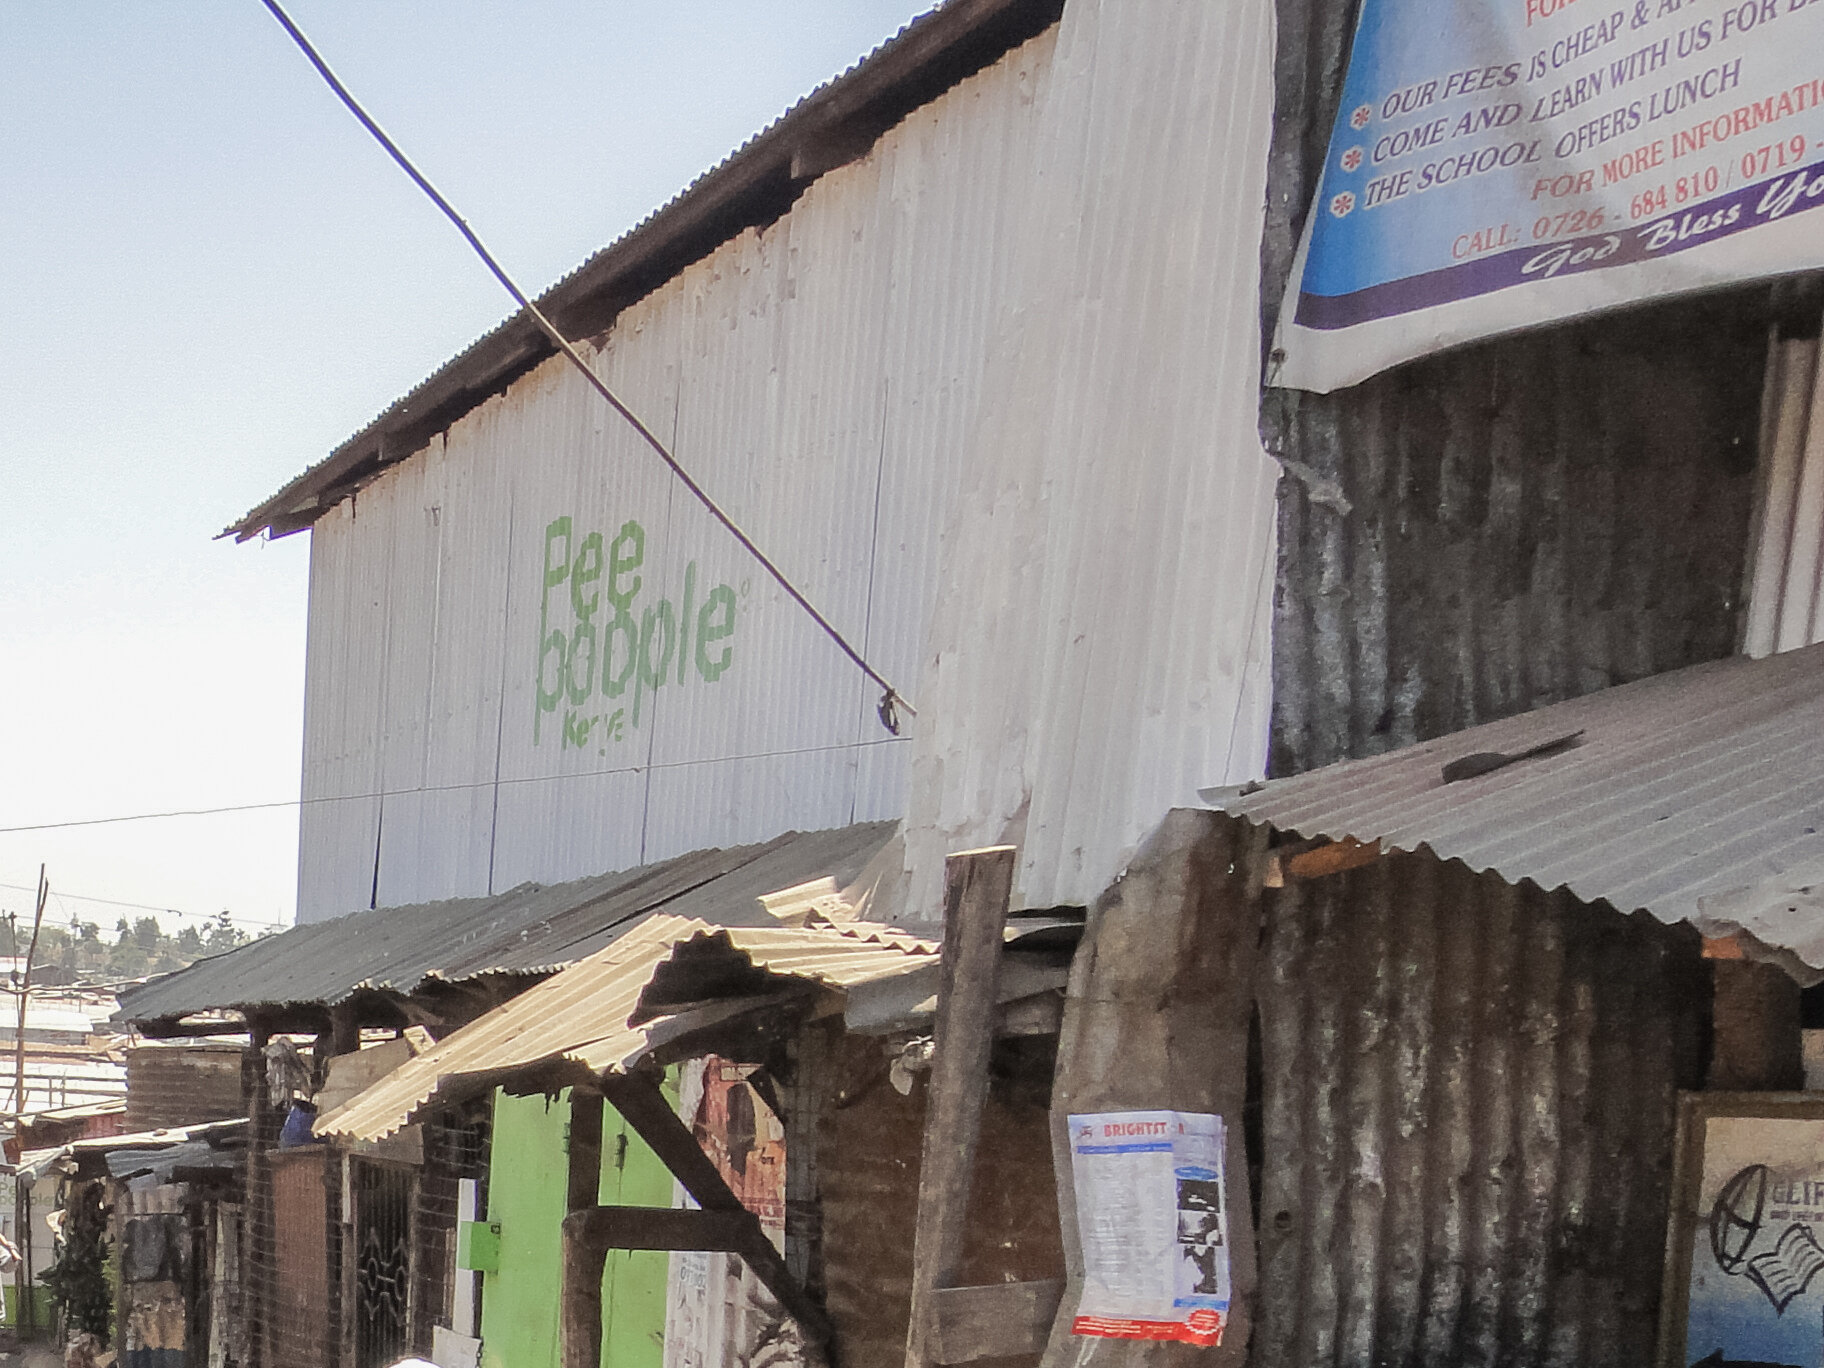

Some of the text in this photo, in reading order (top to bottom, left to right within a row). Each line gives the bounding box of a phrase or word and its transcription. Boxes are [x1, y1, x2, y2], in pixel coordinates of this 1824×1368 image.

[1374, 117, 1450, 163] COME
[1451, 102, 1524, 139] AND
[1528, 68, 1606, 123] LEARN
[1609, 37, 1670, 90] WITH
[1677, 19, 1713, 59] US
[1719, 0, 1777, 41] FOR
[1382, 80, 1439, 120] OUR
[1442, 62, 1522, 100] FEES
[1526, 50, 1547, 83] IS
[1551, 11, 1625, 69] CHEAP
[1629, 0, 1651, 31] &
[1364, 57, 1742, 207] THE SCHOOL OFFERS LUNCH
[1530, 79, 1824, 201] FOR MORE INFORMATI
[1451, 223, 1522, 260] CALL:
[1532, 206, 1606, 241] 0726
[1629, 184, 1668, 221] 684
[1675, 165, 1719, 204] 810
[1741, 134, 1807, 180] 0719
[1521, 235, 1622, 279] God
[1636, 203, 1743, 253] Bless
[541, 515, 646, 621] Pee
